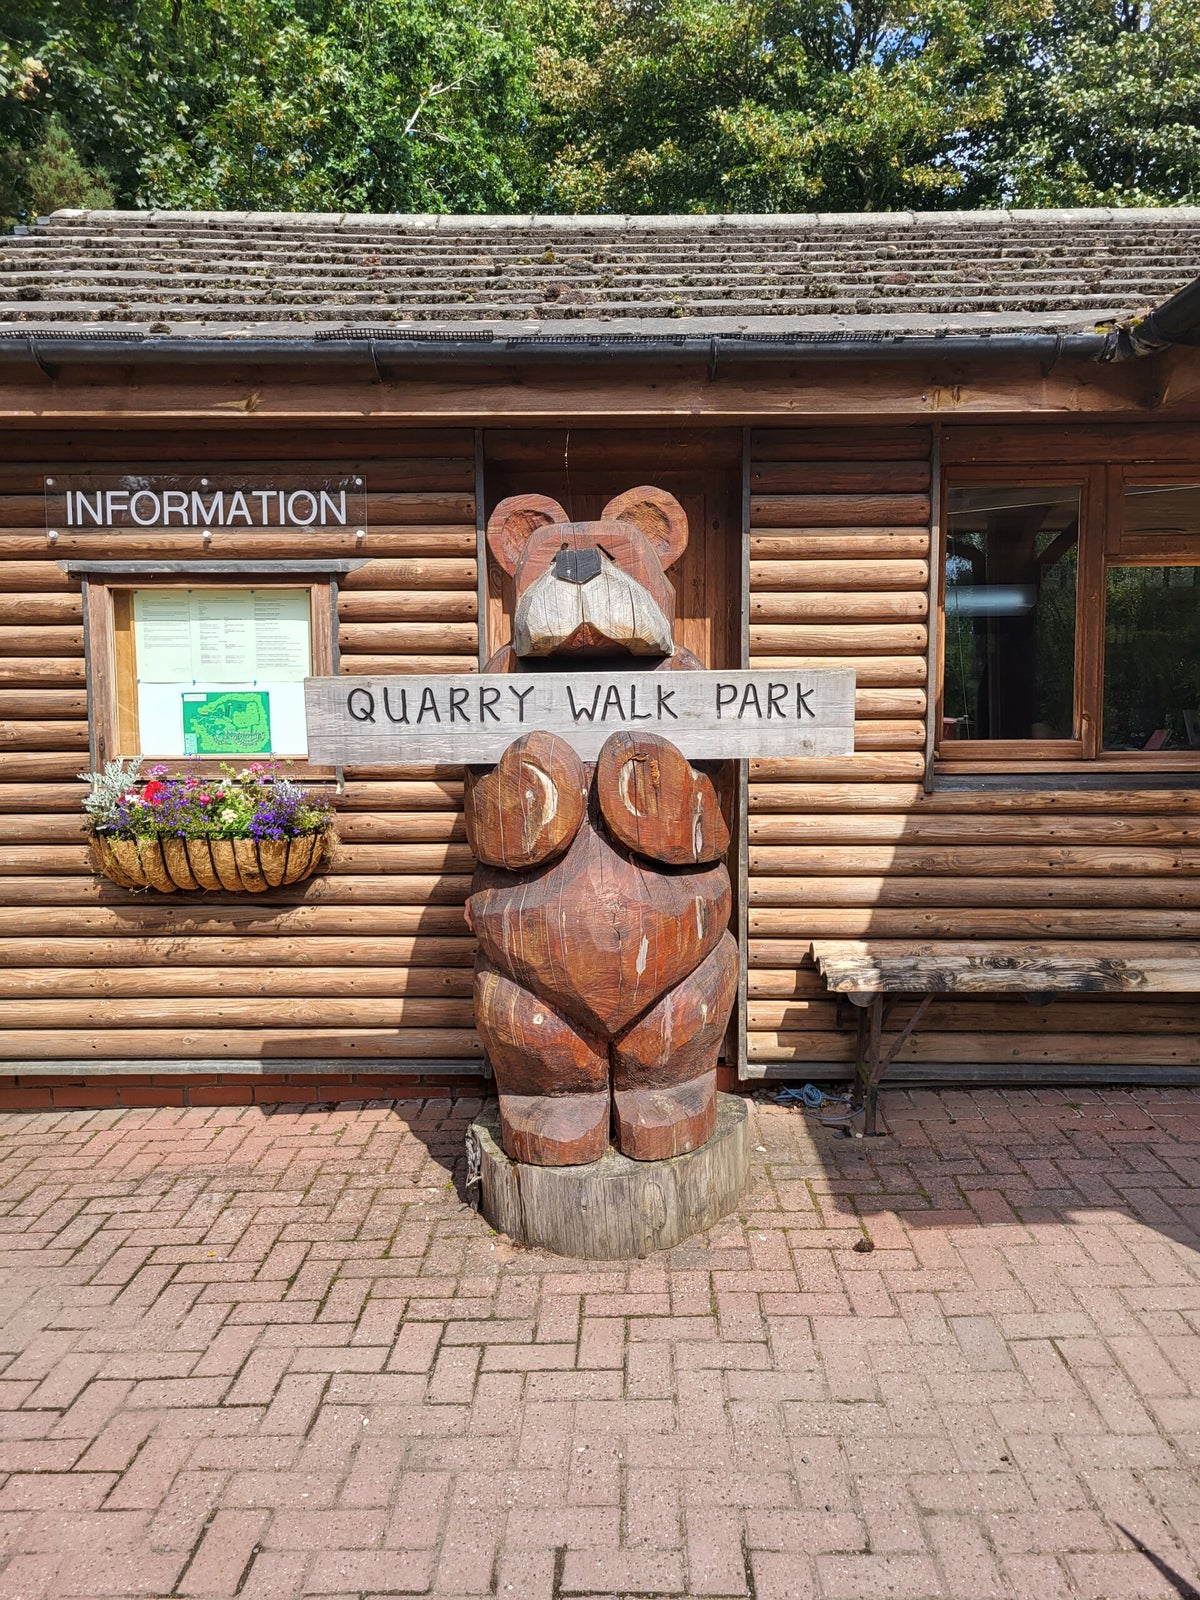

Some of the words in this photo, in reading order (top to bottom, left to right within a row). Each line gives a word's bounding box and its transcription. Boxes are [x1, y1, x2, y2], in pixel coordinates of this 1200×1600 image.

[66, 490, 347, 526] INFORMATION
[347, 685, 535, 724] QUARRY
[566, 684, 678, 721] WALK
[716, 682, 816, 720] PARK
